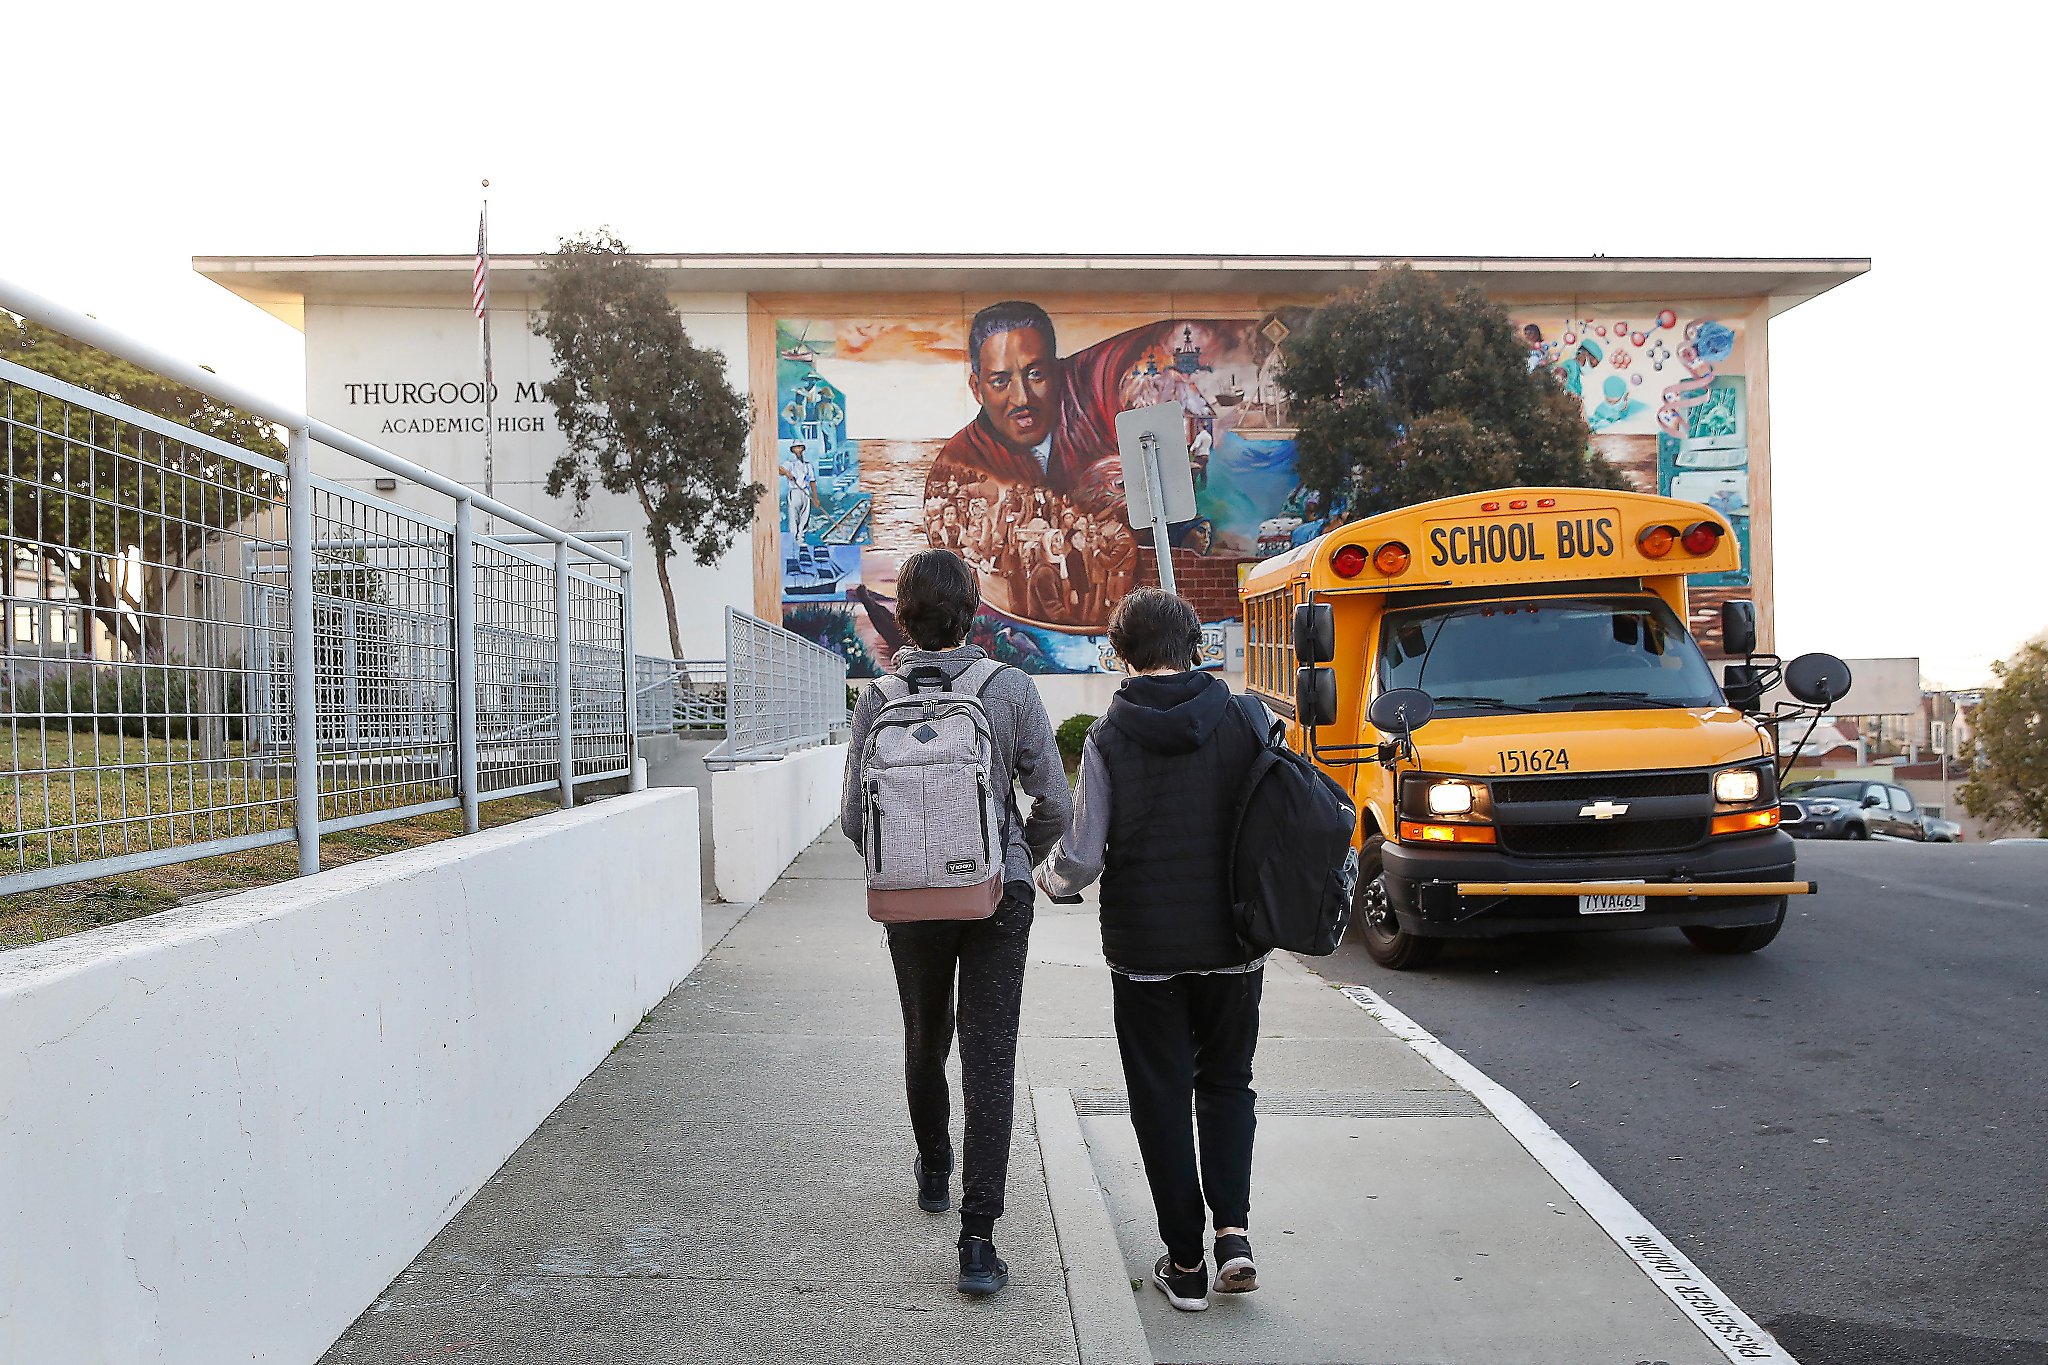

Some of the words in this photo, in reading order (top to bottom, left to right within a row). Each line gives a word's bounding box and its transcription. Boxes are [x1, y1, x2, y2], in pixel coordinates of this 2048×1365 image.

[344, 382, 498, 404] THURGOOD
[381, 417, 484, 433] ACADEMIC
[498, 416, 545, 432] HIGH
[1430, 522, 1545, 566] SCHOOL
[1556, 517, 1614, 559] BUS
[1498, 748, 1569, 773] 151624
[1584, 894, 1640, 909] 7YVA461
[1625, 1234, 1698, 1283] LOADING
[1674, 1285, 1772, 1358] PASSENGER
